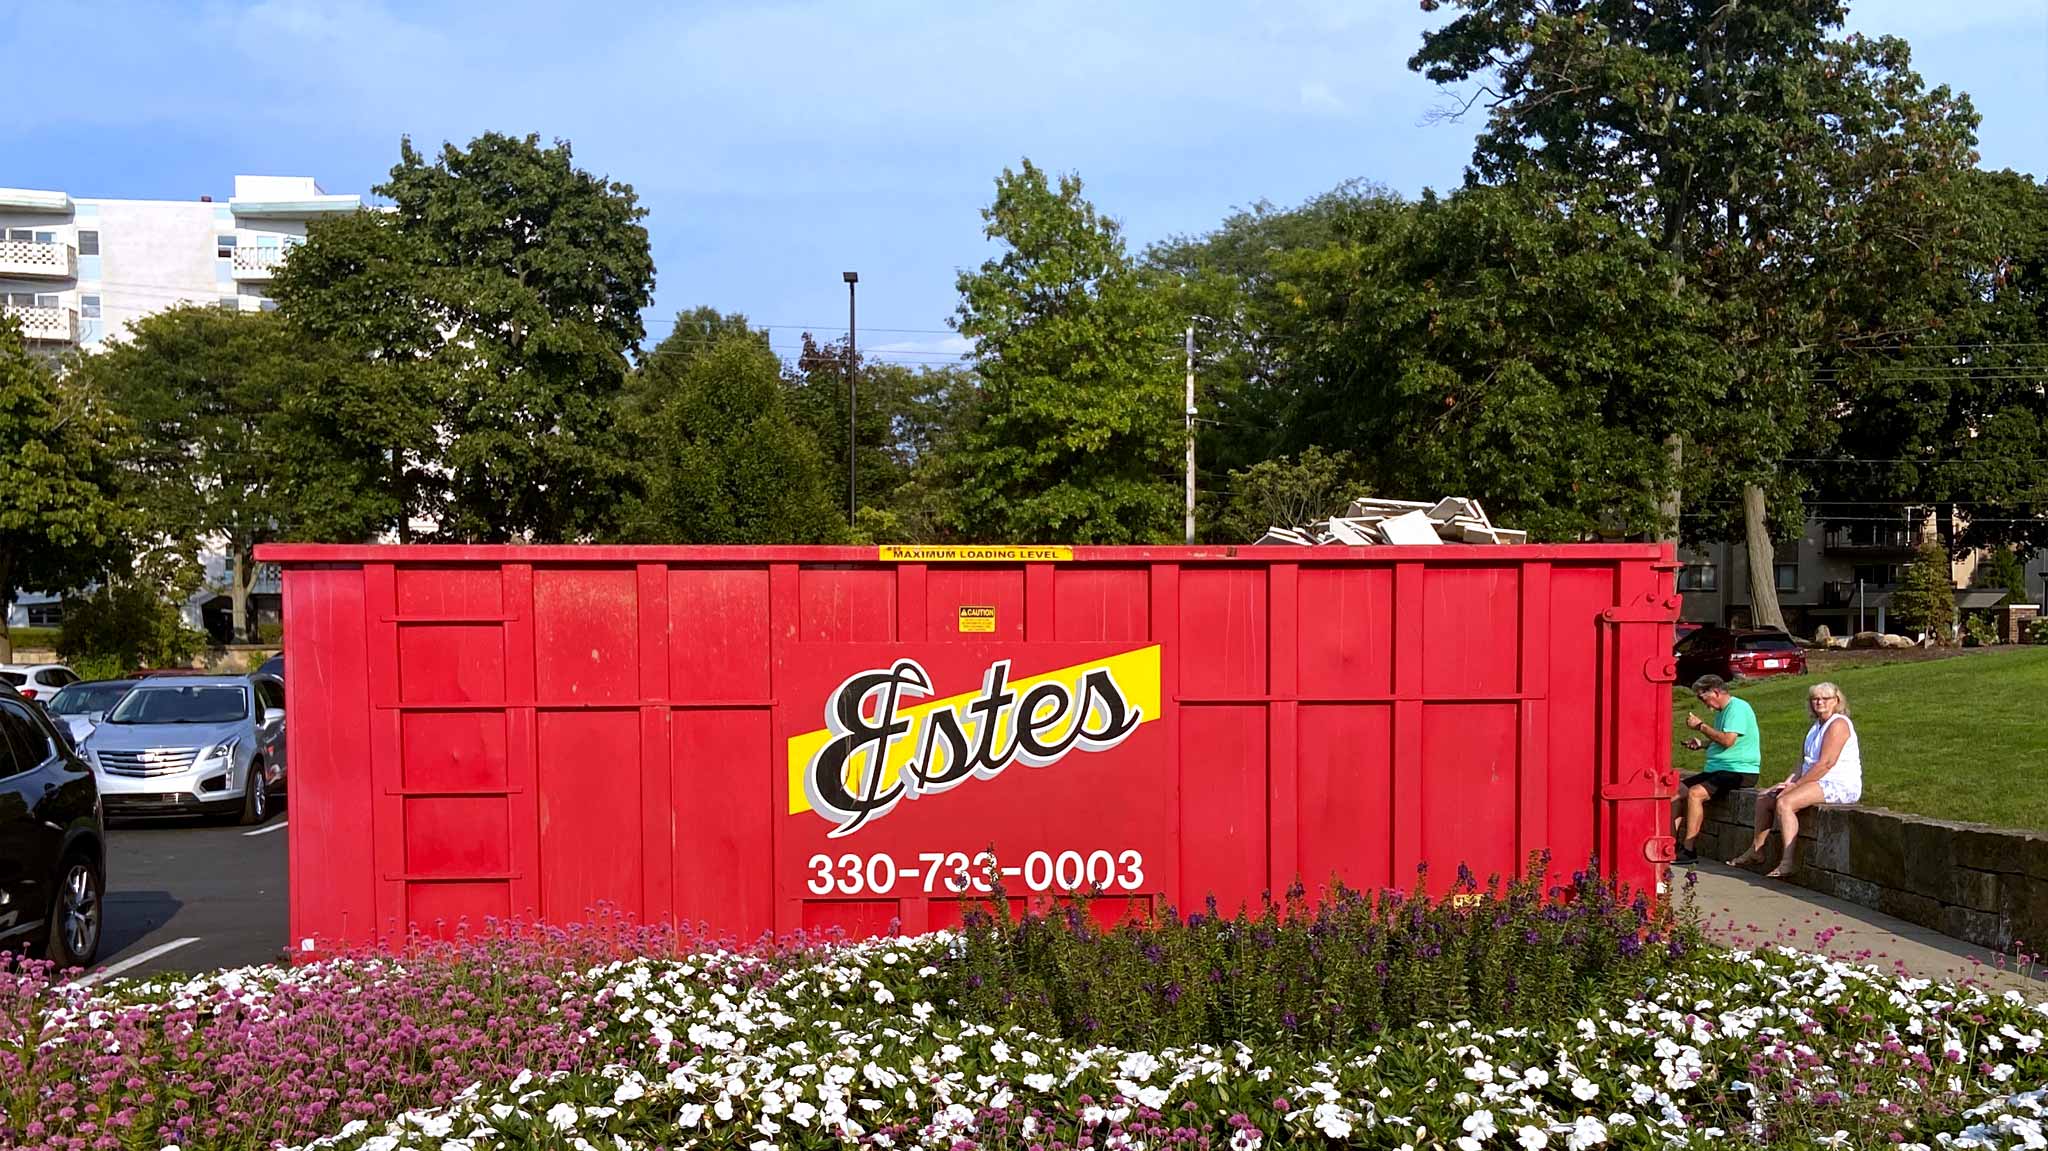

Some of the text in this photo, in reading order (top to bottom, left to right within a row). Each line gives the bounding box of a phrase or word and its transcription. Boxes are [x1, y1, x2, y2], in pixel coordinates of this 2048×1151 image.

[893, 551, 1059, 559] MAXIMUM LOADING LEVEL
[967, 608, 994, 617] CAUTION
[809, 659, 1141, 837] Estes
[806, 850, 1144, 895] 330-733-0003
